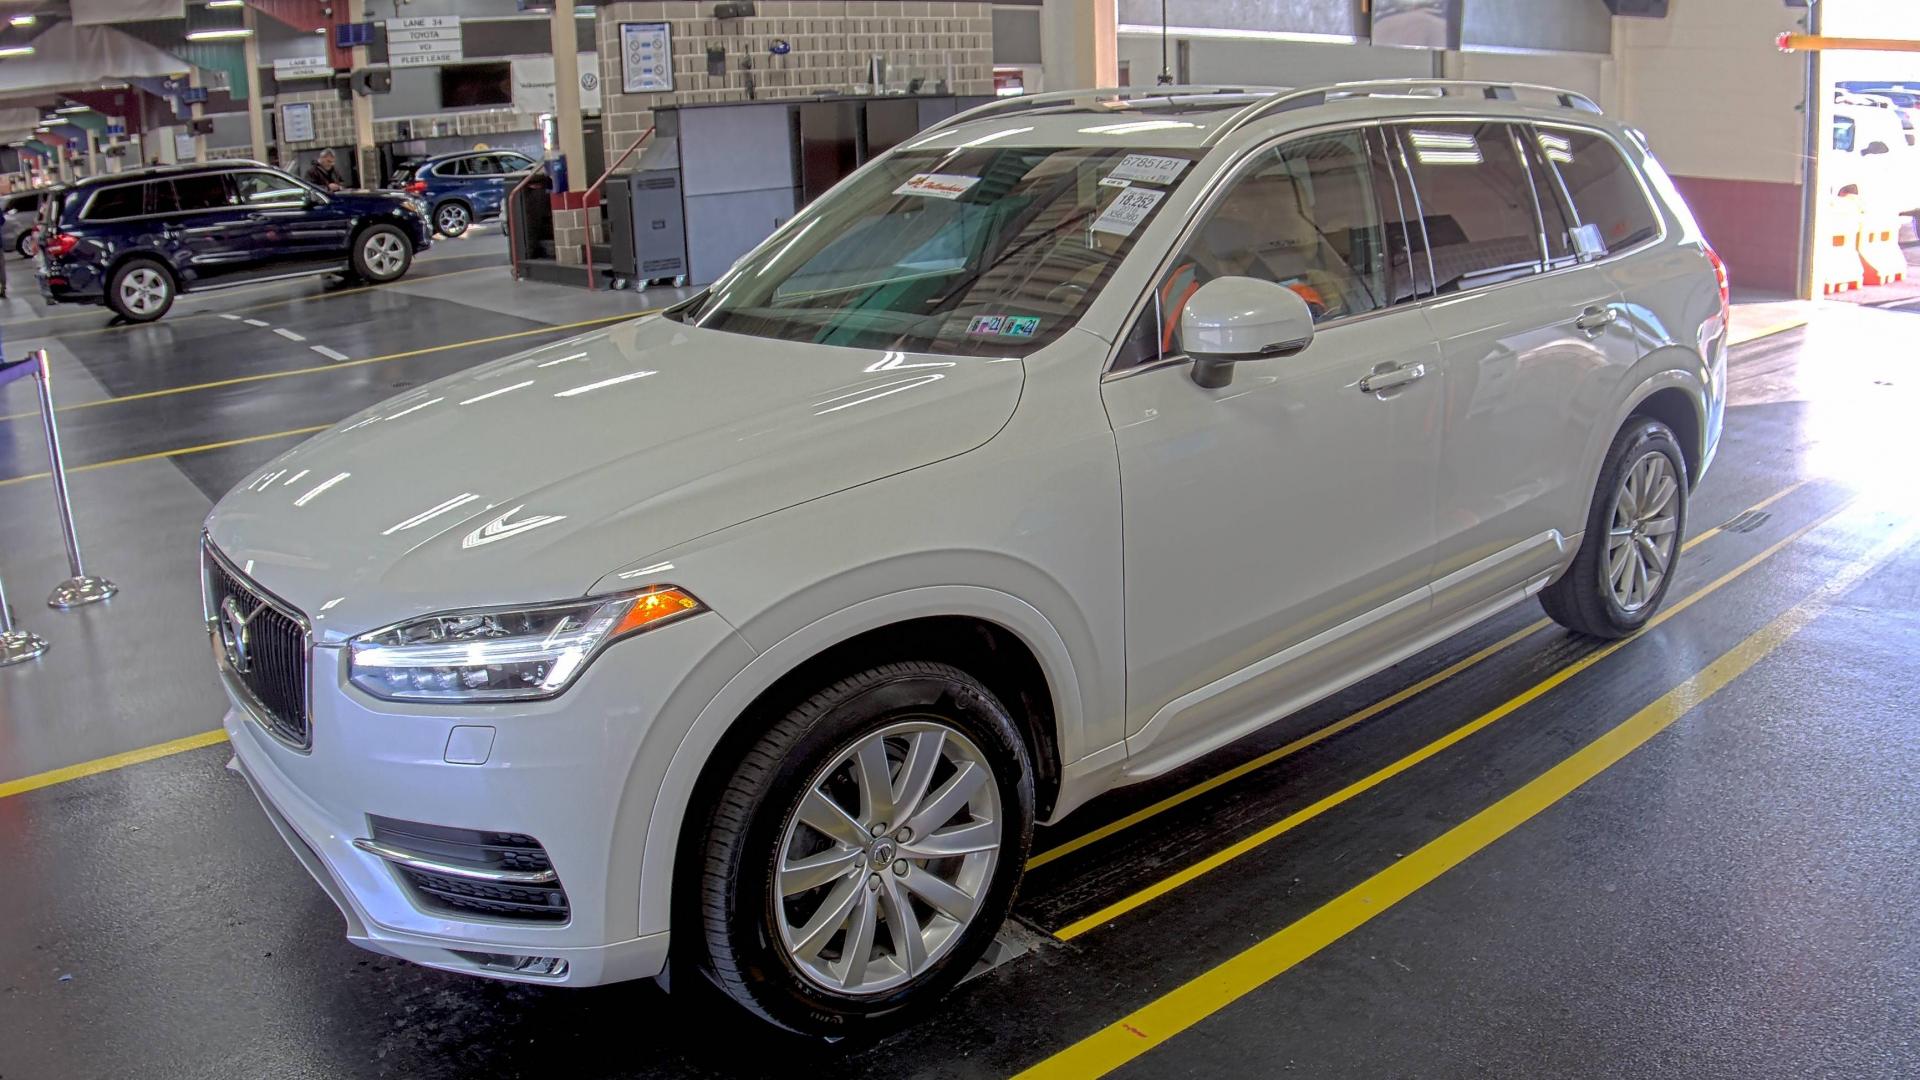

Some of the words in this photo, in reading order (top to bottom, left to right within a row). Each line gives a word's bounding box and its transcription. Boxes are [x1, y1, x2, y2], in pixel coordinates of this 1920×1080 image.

[403, 18, 425, 27] LANE
[432, 18, 442, 26] 34
[409, 30, 439, 39] TOYOTA
[401, 55, 425, 64] FLEET
[426, 54, 450, 62] LEASE
[1121, 156, 1179, 171] 6785121
